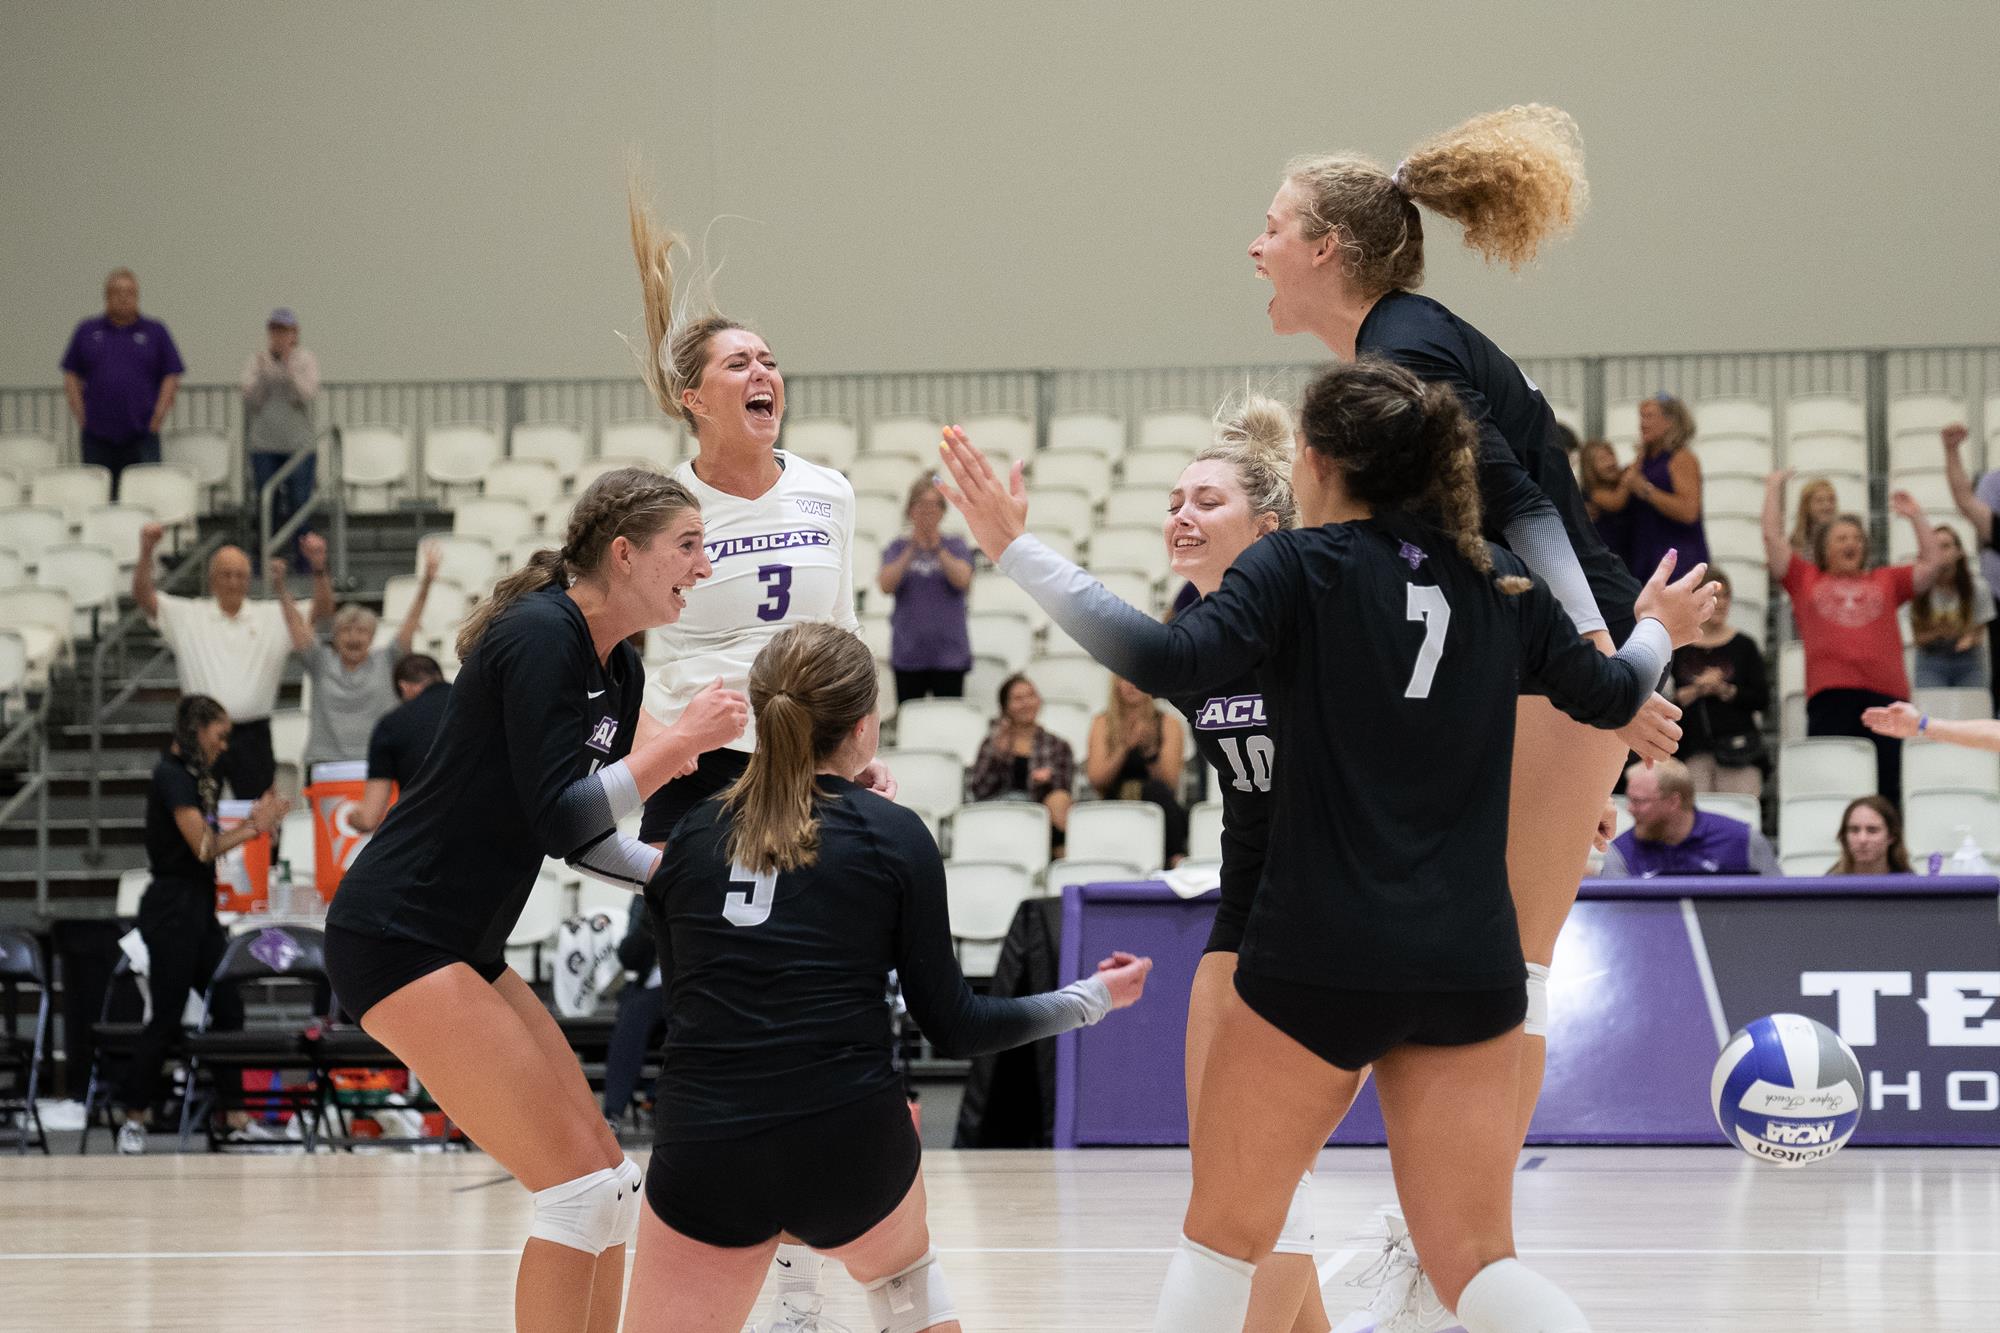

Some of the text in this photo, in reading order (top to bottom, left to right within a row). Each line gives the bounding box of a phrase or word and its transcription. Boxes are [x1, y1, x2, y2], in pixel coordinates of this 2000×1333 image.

[796, 499, 832, 518] WAC
[757, 564, 793, 621] 3
[1404, 582, 1451, 698] 7
[1218, 735, 1275, 792] 10
[1764, 1092, 1844, 1111] Super Touch
[1869, 1070, 2000, 1111] HO
[1756, 1142, 1839, 1162] molten
